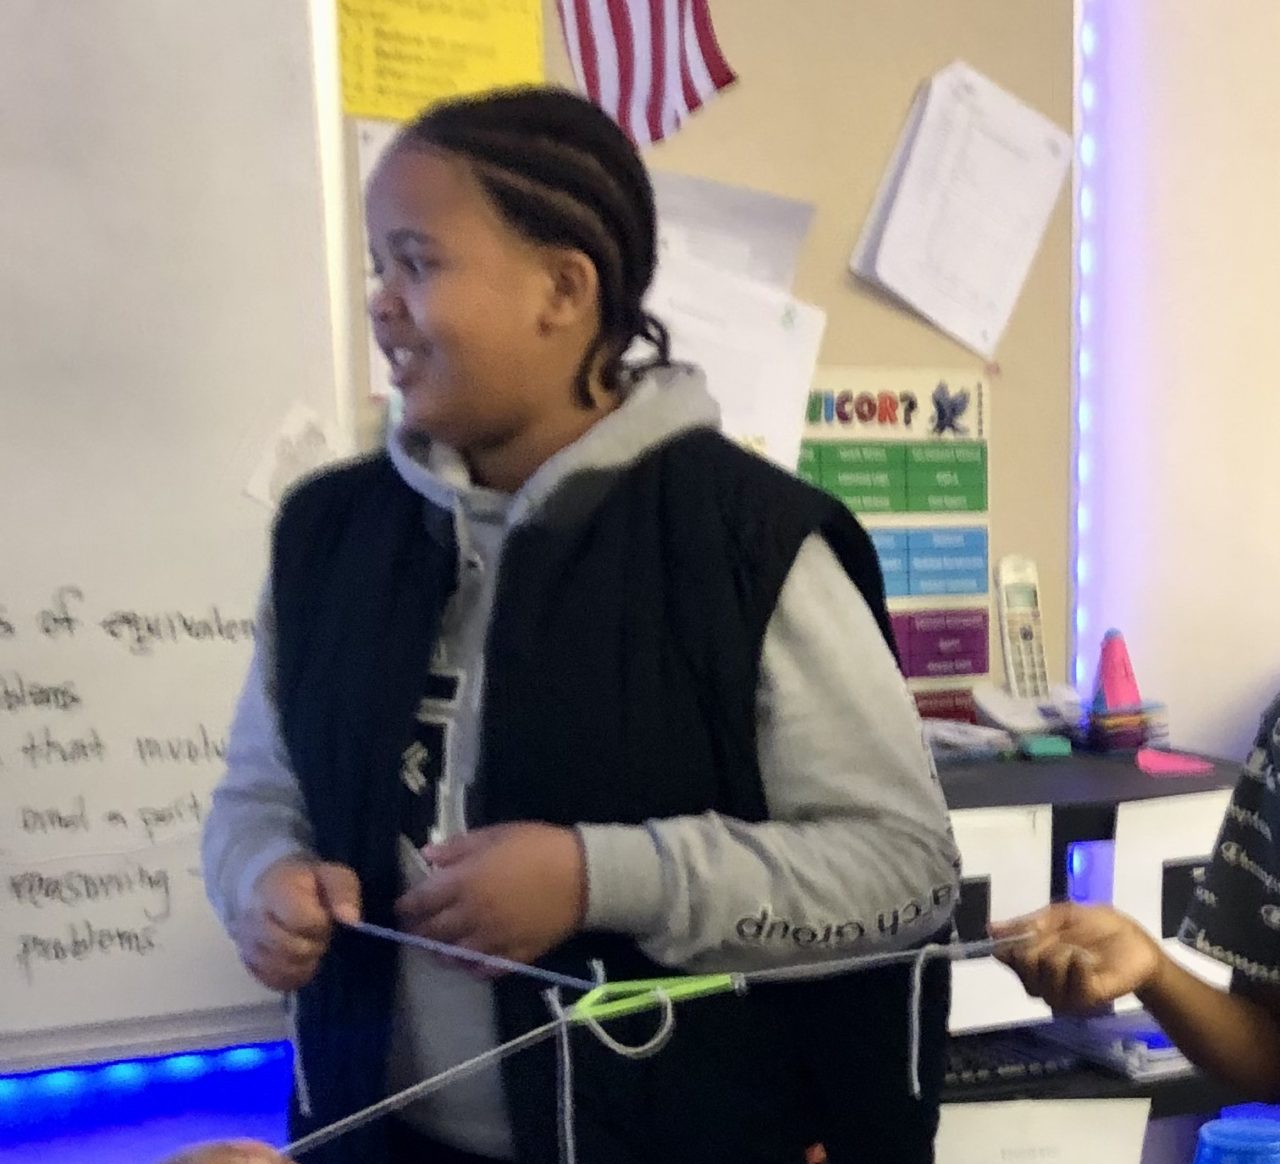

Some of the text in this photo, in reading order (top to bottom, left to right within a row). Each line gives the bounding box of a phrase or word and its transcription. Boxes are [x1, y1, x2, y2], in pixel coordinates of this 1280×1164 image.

[36, 585, 84, 637] of
[22, 726, 105, 767] that
[21, 795, 89, 833] and
[10, 865, 171, 922] reasoning
[17, 920, 157, 986] problems
